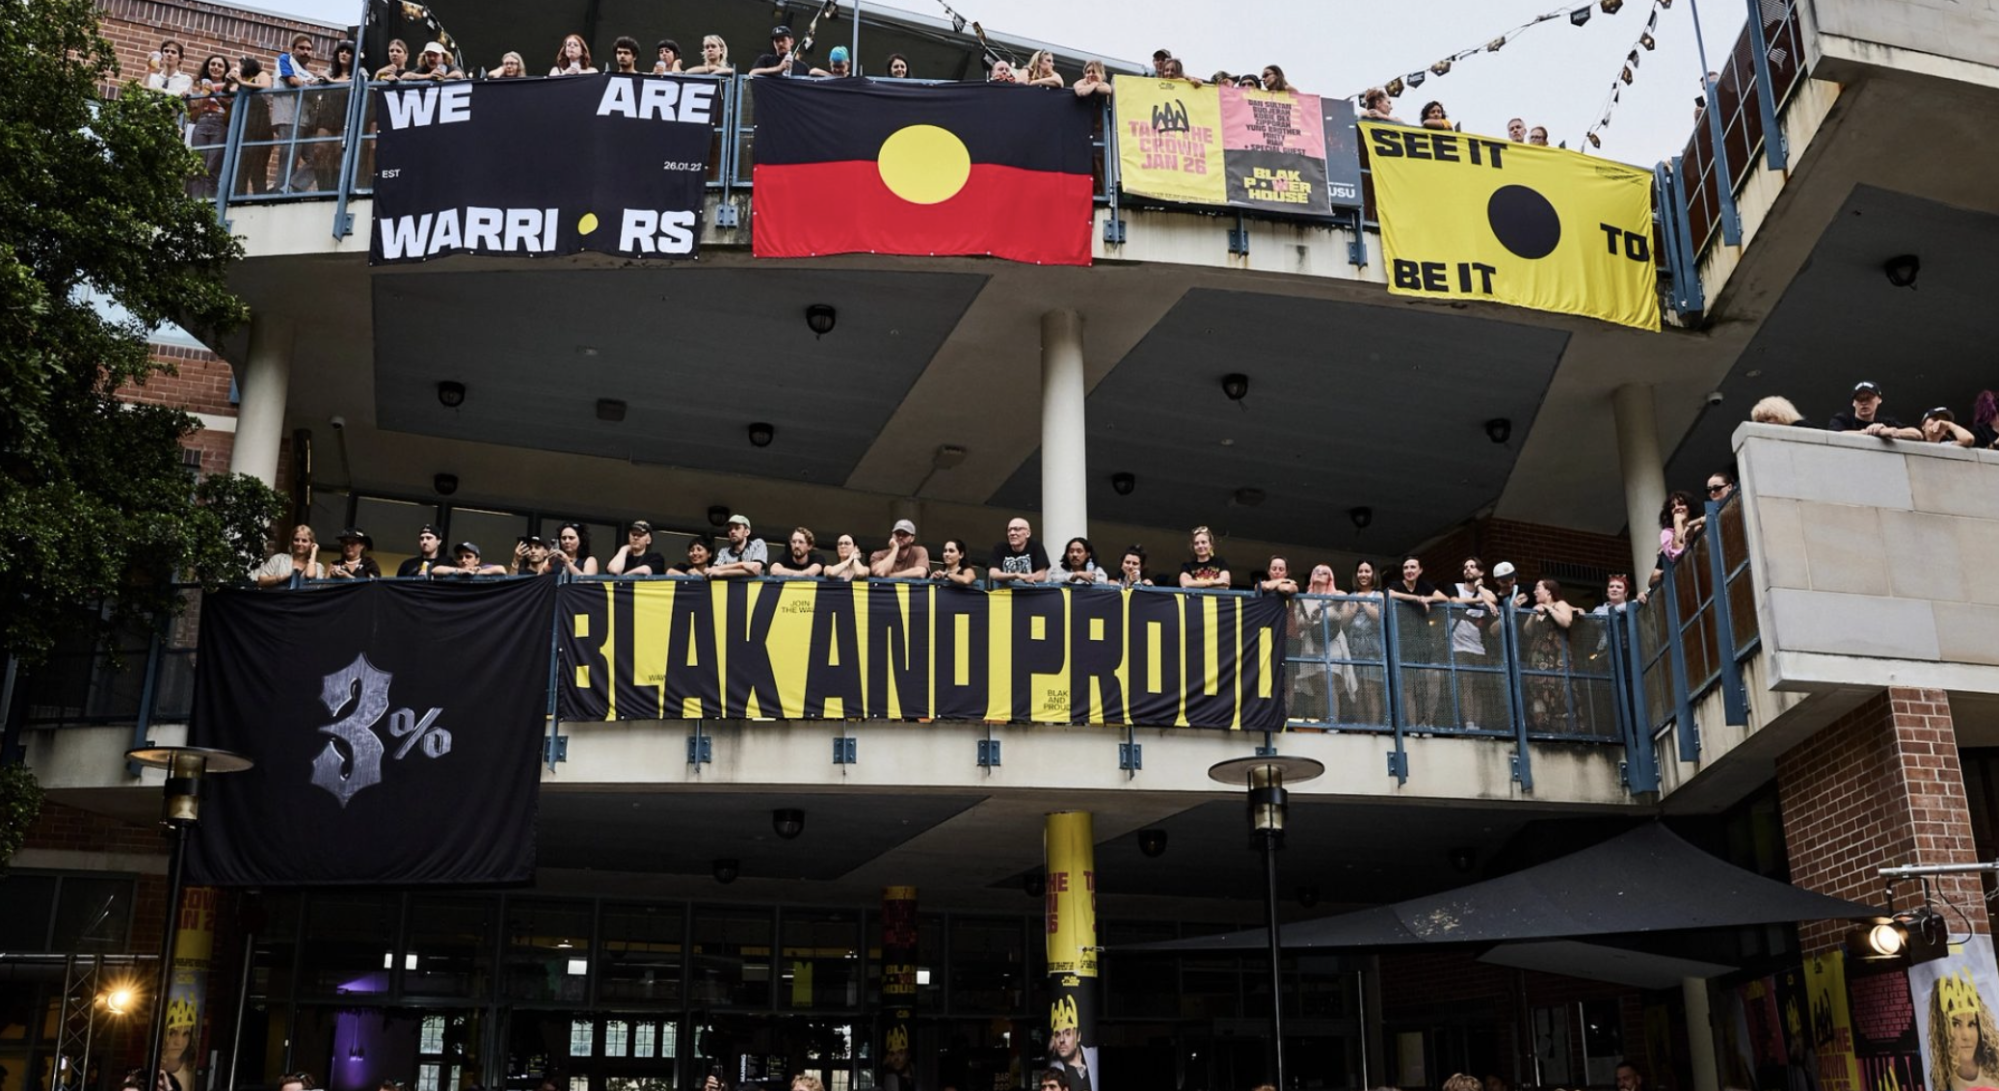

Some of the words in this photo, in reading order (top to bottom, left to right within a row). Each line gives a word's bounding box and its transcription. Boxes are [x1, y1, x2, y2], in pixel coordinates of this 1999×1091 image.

[384, 83, 473, 130] WE
[596, 77, 717, 124] ARE
[1140, 138, 1206, 158] CROWN
[1370, 128, 1460, 162] SEE
[1468, 138, 1508, 169] IT
[382, 169, 401, 178] EST
[1141, 154, 1178, 171] JAN
[1183, 157, 1207, 175] 26
[1253, 167, 1301, 182] BLAK
[1248, 188, 1309, 203] HOUSE
[1599, 222, 1650, 262] TO
[1393, 259, 1449, 293] BE
[1457, 262, 1496, 295] IT
[561, 581, 785, 720] BLAK
[803, 582, 990, 719] AND
[1011, 586, 1286, 732] PROUD
